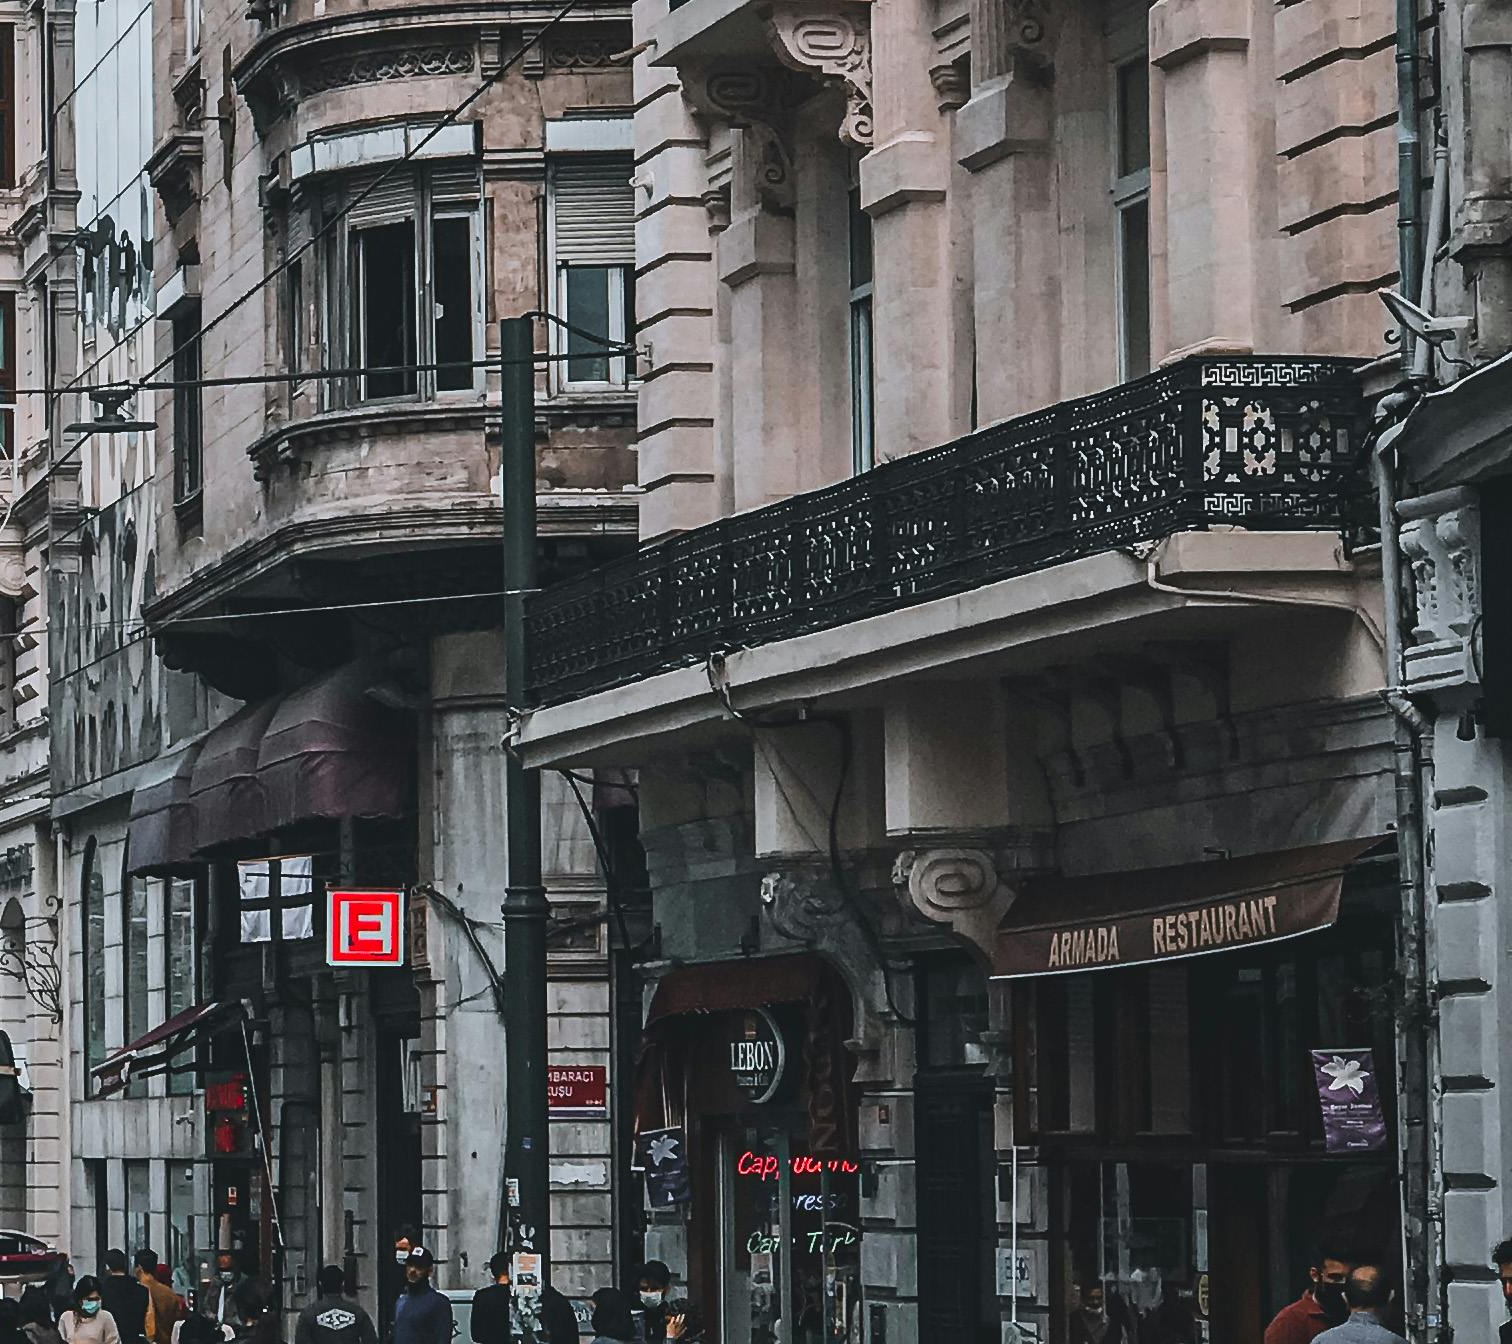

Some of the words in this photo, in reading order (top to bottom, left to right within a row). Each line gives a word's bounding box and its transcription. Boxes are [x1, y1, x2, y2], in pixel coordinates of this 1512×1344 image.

[1048, 925, 1120, 968] ARMADA
[1152, 896, 1277, 955] RESTAURANT
[730, 1041, 774, 1071] LEBON
